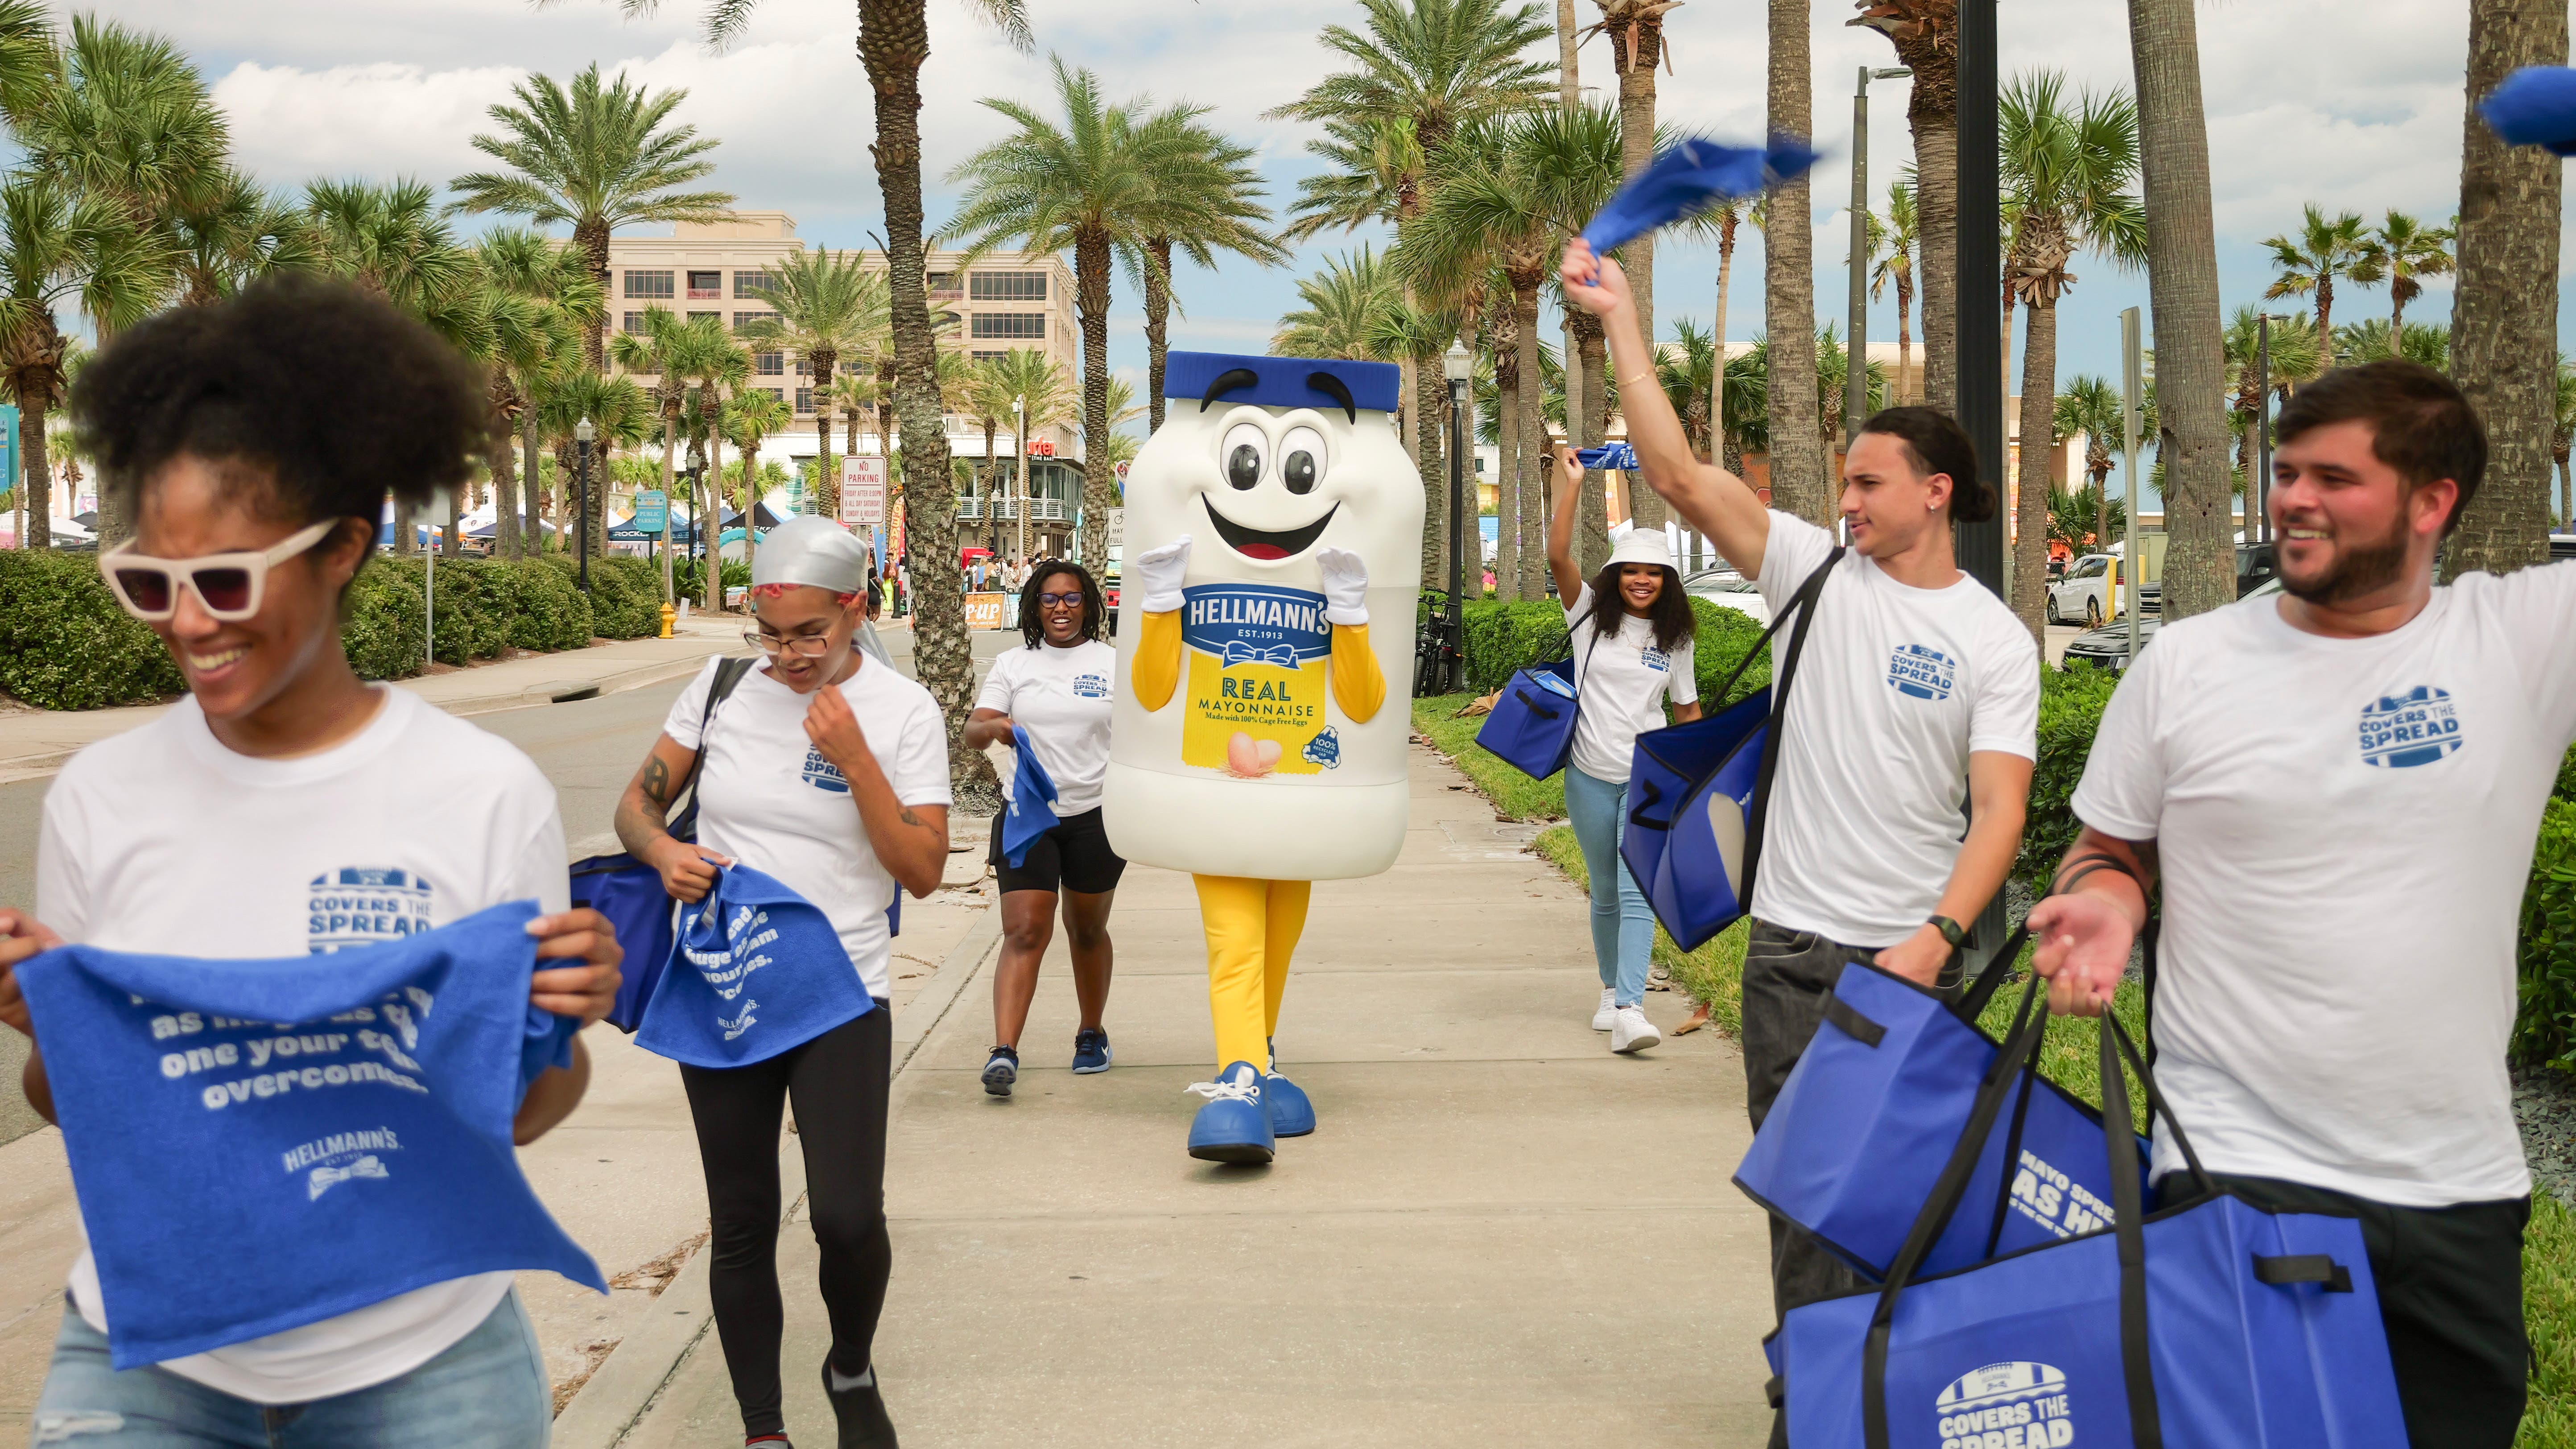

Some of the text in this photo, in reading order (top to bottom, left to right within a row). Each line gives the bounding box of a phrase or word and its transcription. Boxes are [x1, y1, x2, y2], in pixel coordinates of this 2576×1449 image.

[859, 462, 868, 471] NO
[848, 474, 879, 483] PARKING
[1190, 599, 1330, 635] HELLMANN'S
[1641, 655, 1669, 667] SPREAD
[1642, 652, 1663, 660] COVERS
[1892, 655, 1954, 679] COVERS THE
[1891, 663, 1952, 689] SPREAD
[1222, 677, 1291, 701] REAL
[1198, 698, 1313, 716] MAYONNAISE
[1205, 712, 1224, 720] Made
[1225, 714, 1239, 722] with
[1241, 715, 1258, 723] 100%
[1259, 717, 1276, 726] Cage
[1293, 718, 1308, 727] Eggs
[2359, 704, 2456, 733] COVERS THE
[1315, 738, 1336, 750] 100%
[2359, 717, 2459, 750] SPREAD
[1313, 745, 1334, 755] RECYCLED
[310, 897, 432, 917] COVERS THE
[309, 914, 432, 935] SPREAD
[702, 962, 743, 983] our
[151, 1011, 205, 1041] as
[160, 1042, 239, 1079] one
[246, 1032, 350, 1067] your
[2010, 1168, 2062, 1217] AS
[2019, 1149, 2116, 1225] MAYO SPRE
[1939, 1394, 2070, 1439] COVERS THE
